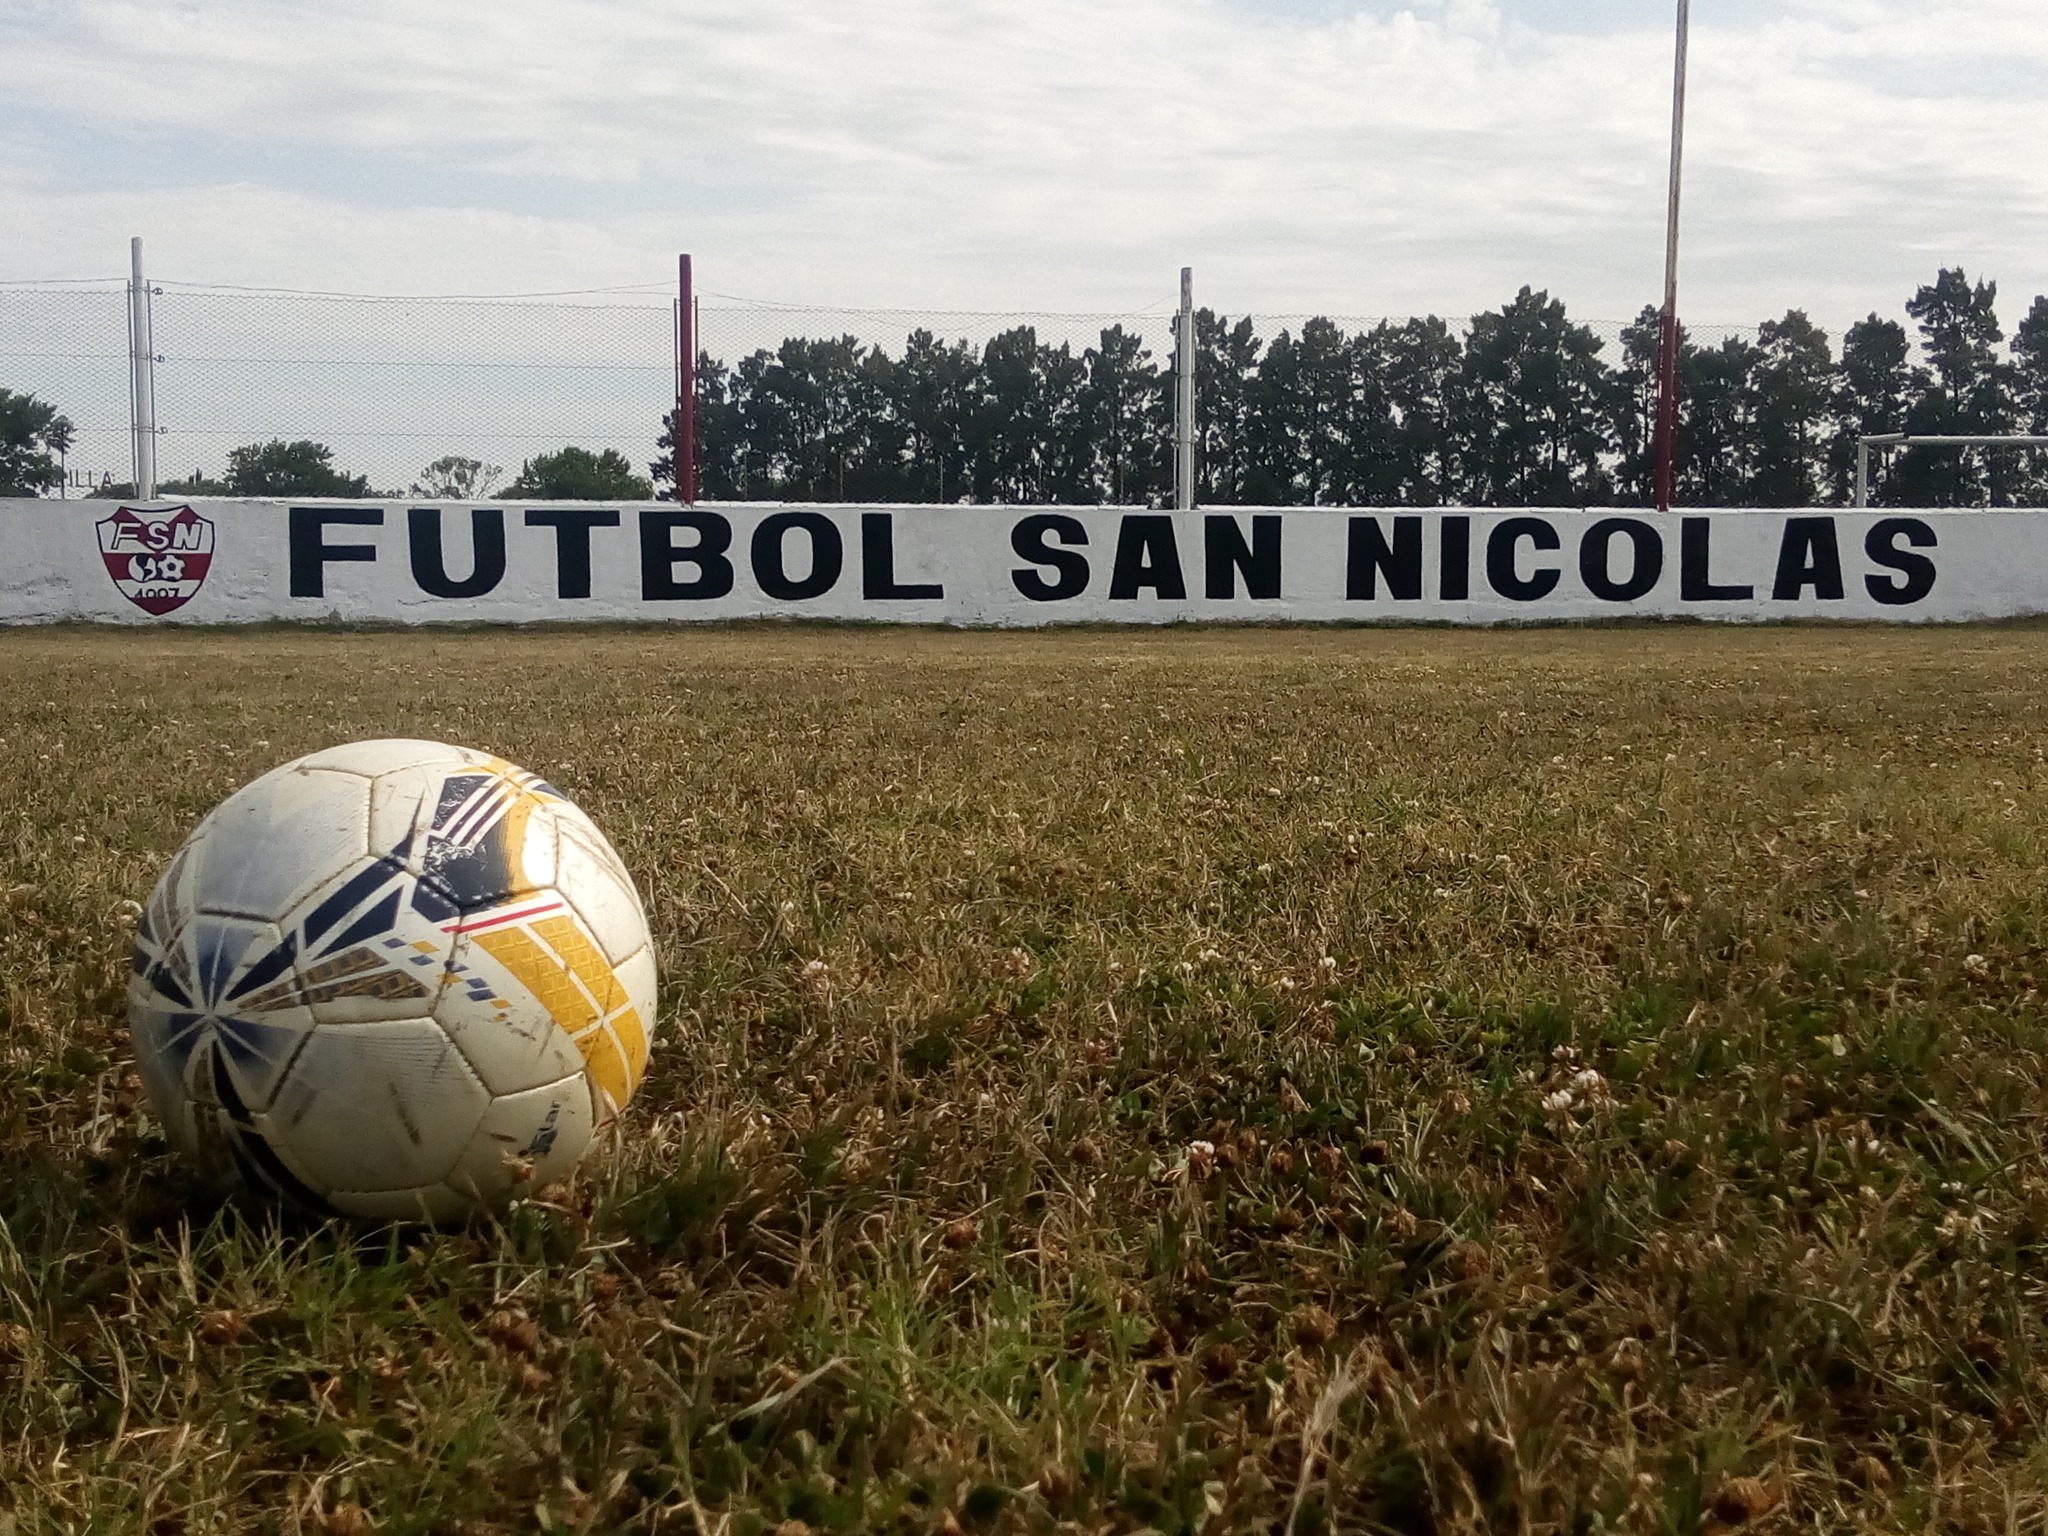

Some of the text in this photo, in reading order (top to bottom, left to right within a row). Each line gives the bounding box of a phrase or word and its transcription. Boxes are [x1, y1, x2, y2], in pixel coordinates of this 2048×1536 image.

[111, 521, 203, 551] FSN
[289, 507, 1938, 605] FUTBOL SAN NICOLAS
